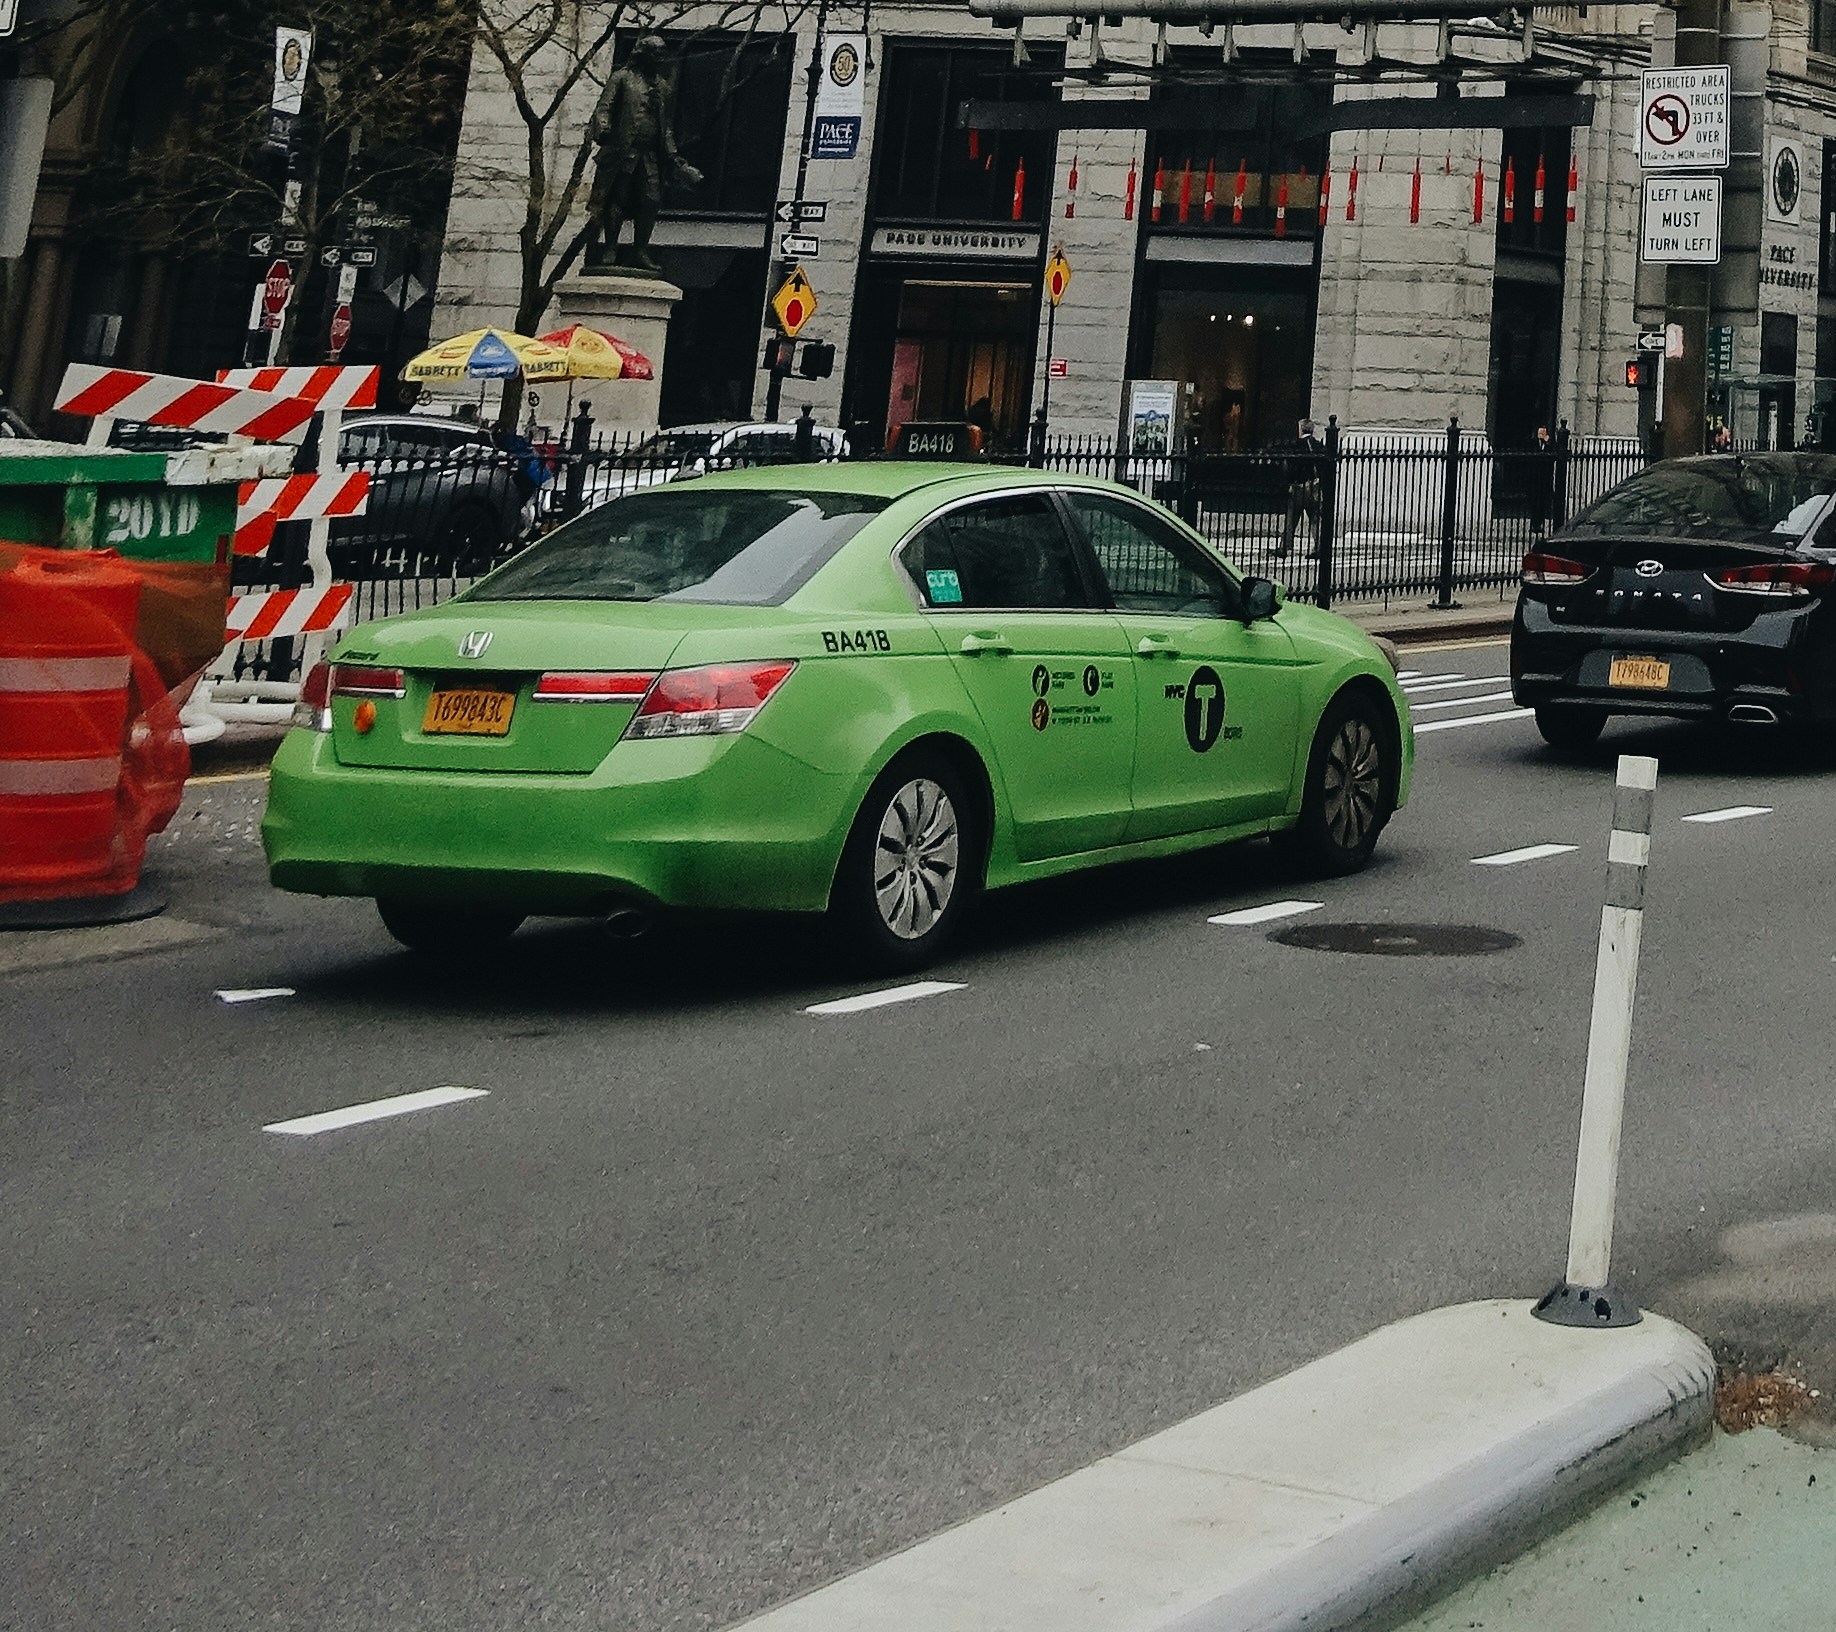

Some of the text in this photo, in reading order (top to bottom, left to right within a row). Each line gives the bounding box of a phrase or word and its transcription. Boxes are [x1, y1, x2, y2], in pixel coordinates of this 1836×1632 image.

[1646, 74, 1725, 90] RESTRICTED AREA
[1690, 93, 1725, 106] TRUCKS
[1693, 112, 1702, 125] 33
[1705, 112, 1714, 124] FT
[820, 122, 855, 139] PACE
[1696, 130, 1720, 143] OVER
[1678, 149, 1695, 160] MON
[1651, 188, 1714, 202] LEFT LANE
[1662, 211, 1701, 228] MUST
[886, 232, 926, 245] PACE
[1650, 237, 1712, 251] TURN LEFT
[908, 432, 954, 453] BA418
[821, 629, 892, 652] BA418
